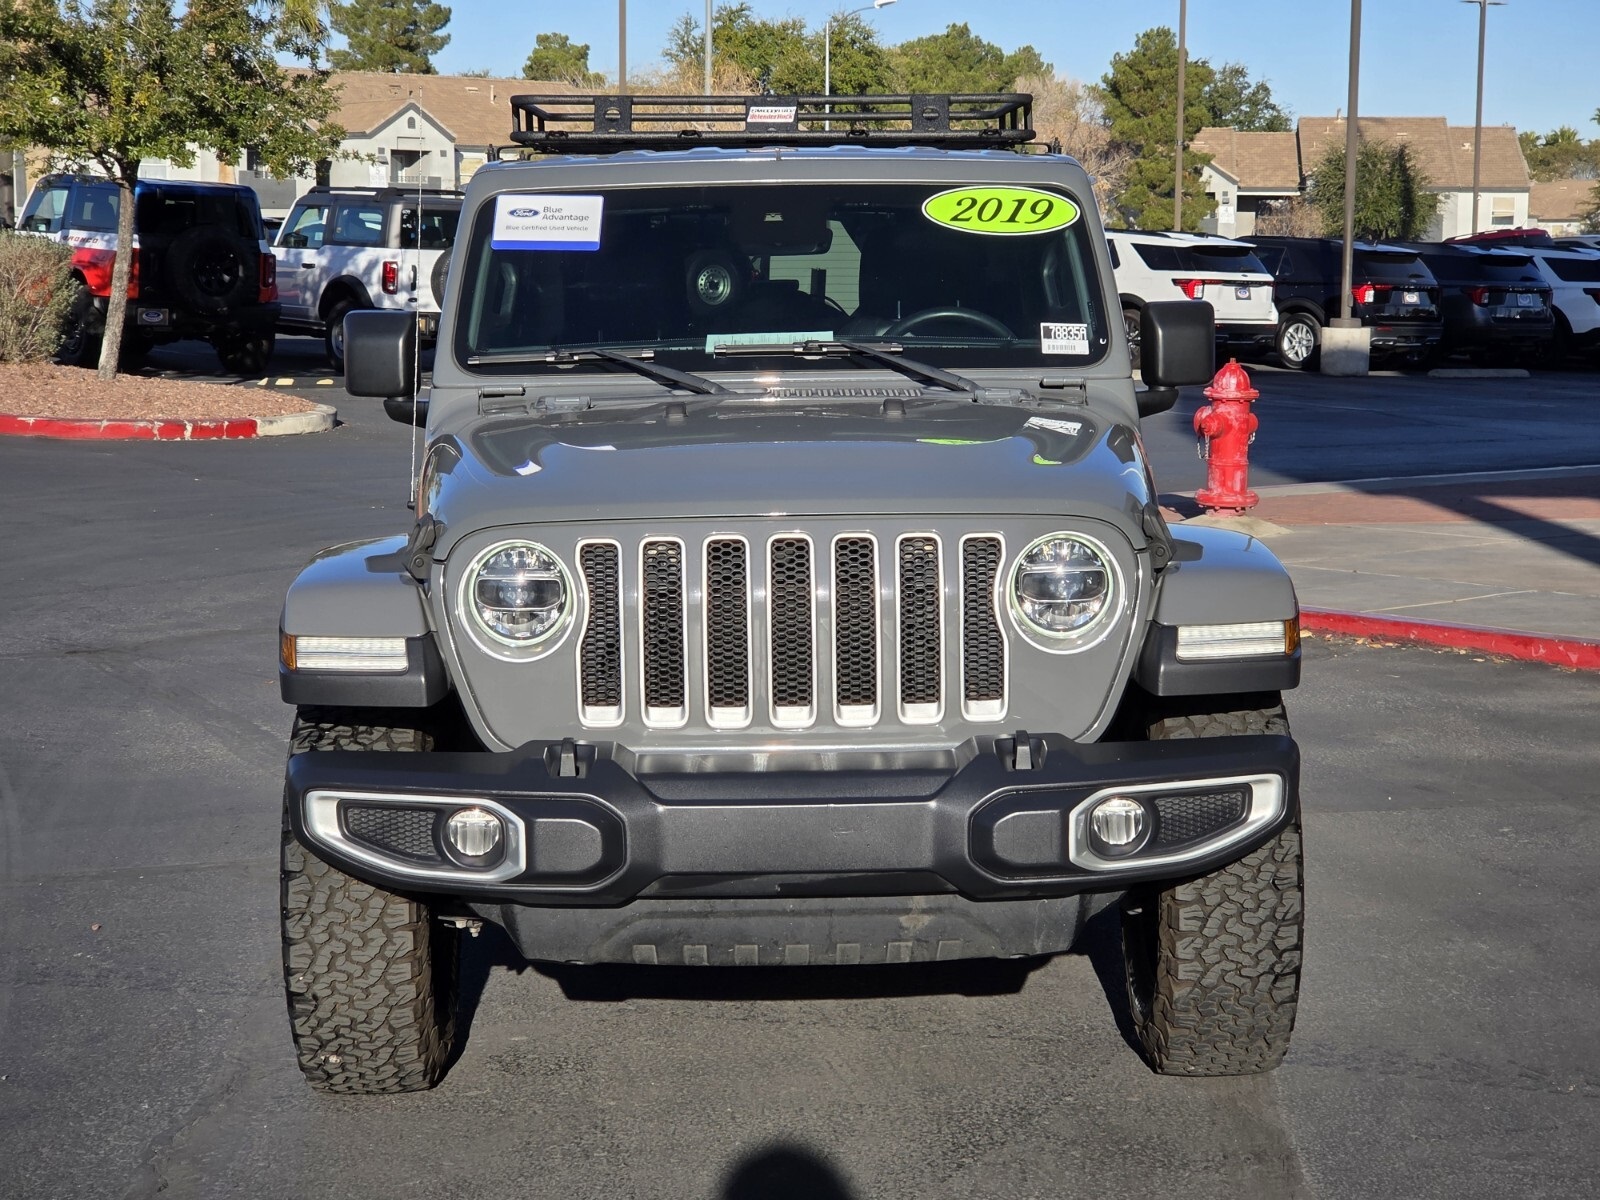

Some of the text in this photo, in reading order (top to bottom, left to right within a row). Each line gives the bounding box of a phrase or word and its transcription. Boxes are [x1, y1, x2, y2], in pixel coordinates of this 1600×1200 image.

[513, 209, 534, 217] Ford
[949, 197, 1054, 224] 2019
[542, 214, 590, 222] Advantage
[1049, 326, 1087, 340] 78835A
